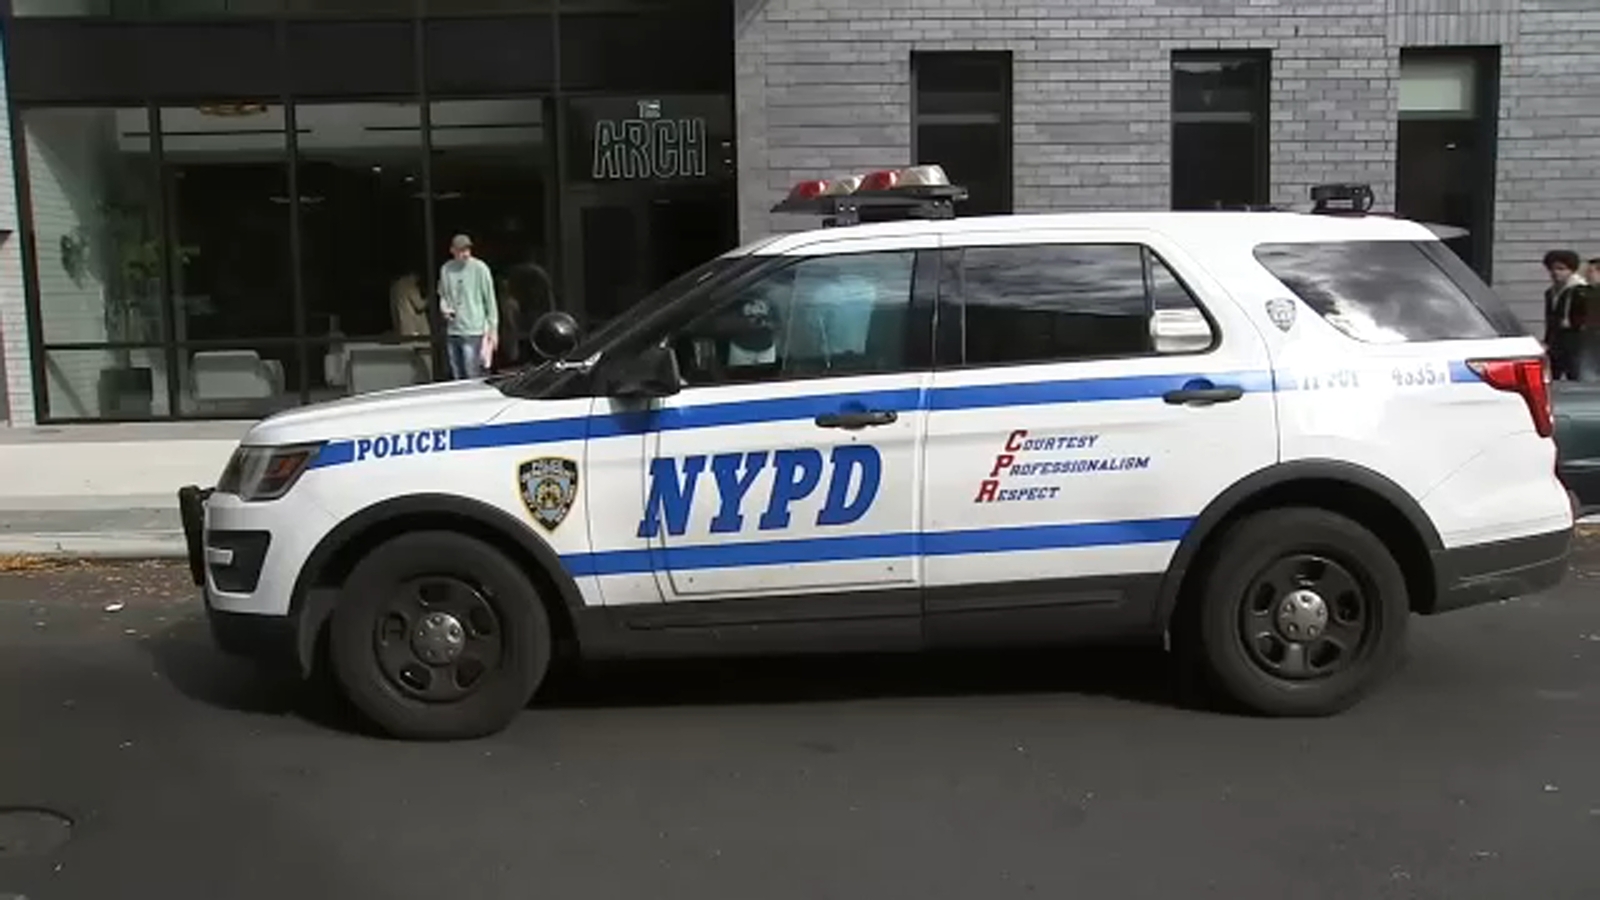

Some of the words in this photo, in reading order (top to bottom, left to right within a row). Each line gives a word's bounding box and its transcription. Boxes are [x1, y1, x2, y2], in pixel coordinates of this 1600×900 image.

[593, 118, 706, 178] ARCH
[357, 429, 446, 460] POLICE
[637, 444, 882, 538] NYPD
[974, 479, 1060, 503] RESPECT
